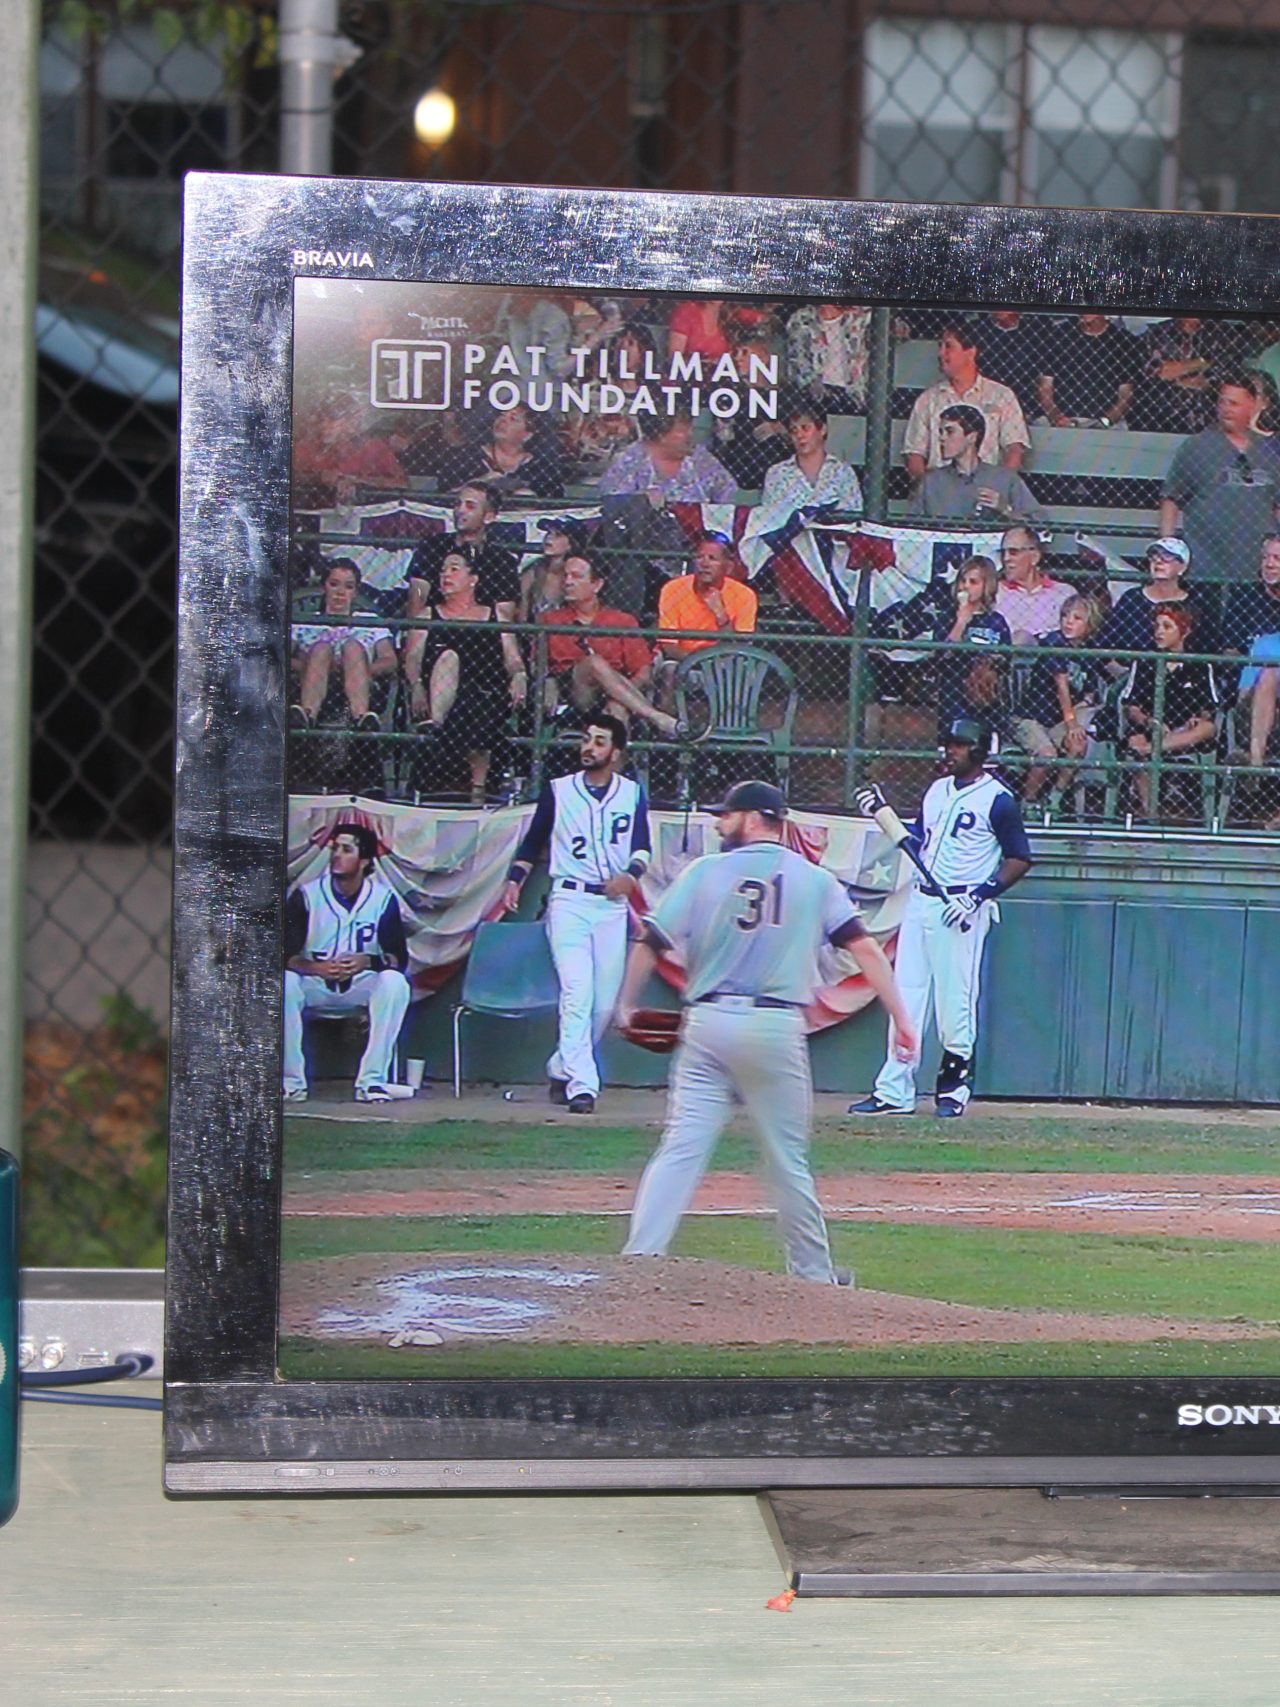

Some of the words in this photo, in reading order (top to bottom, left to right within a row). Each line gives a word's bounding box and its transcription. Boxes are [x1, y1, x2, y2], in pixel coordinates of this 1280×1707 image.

[293, 249, 374, 268] BRAVIA
[464, 343, 547, 377] PAT
[570, 347, 779, 385] TILLMAN
[463, 379, 779, 420] FOUNDATION
[609, 811, 632, 845] P
[736, 873, 784, 932] 31
